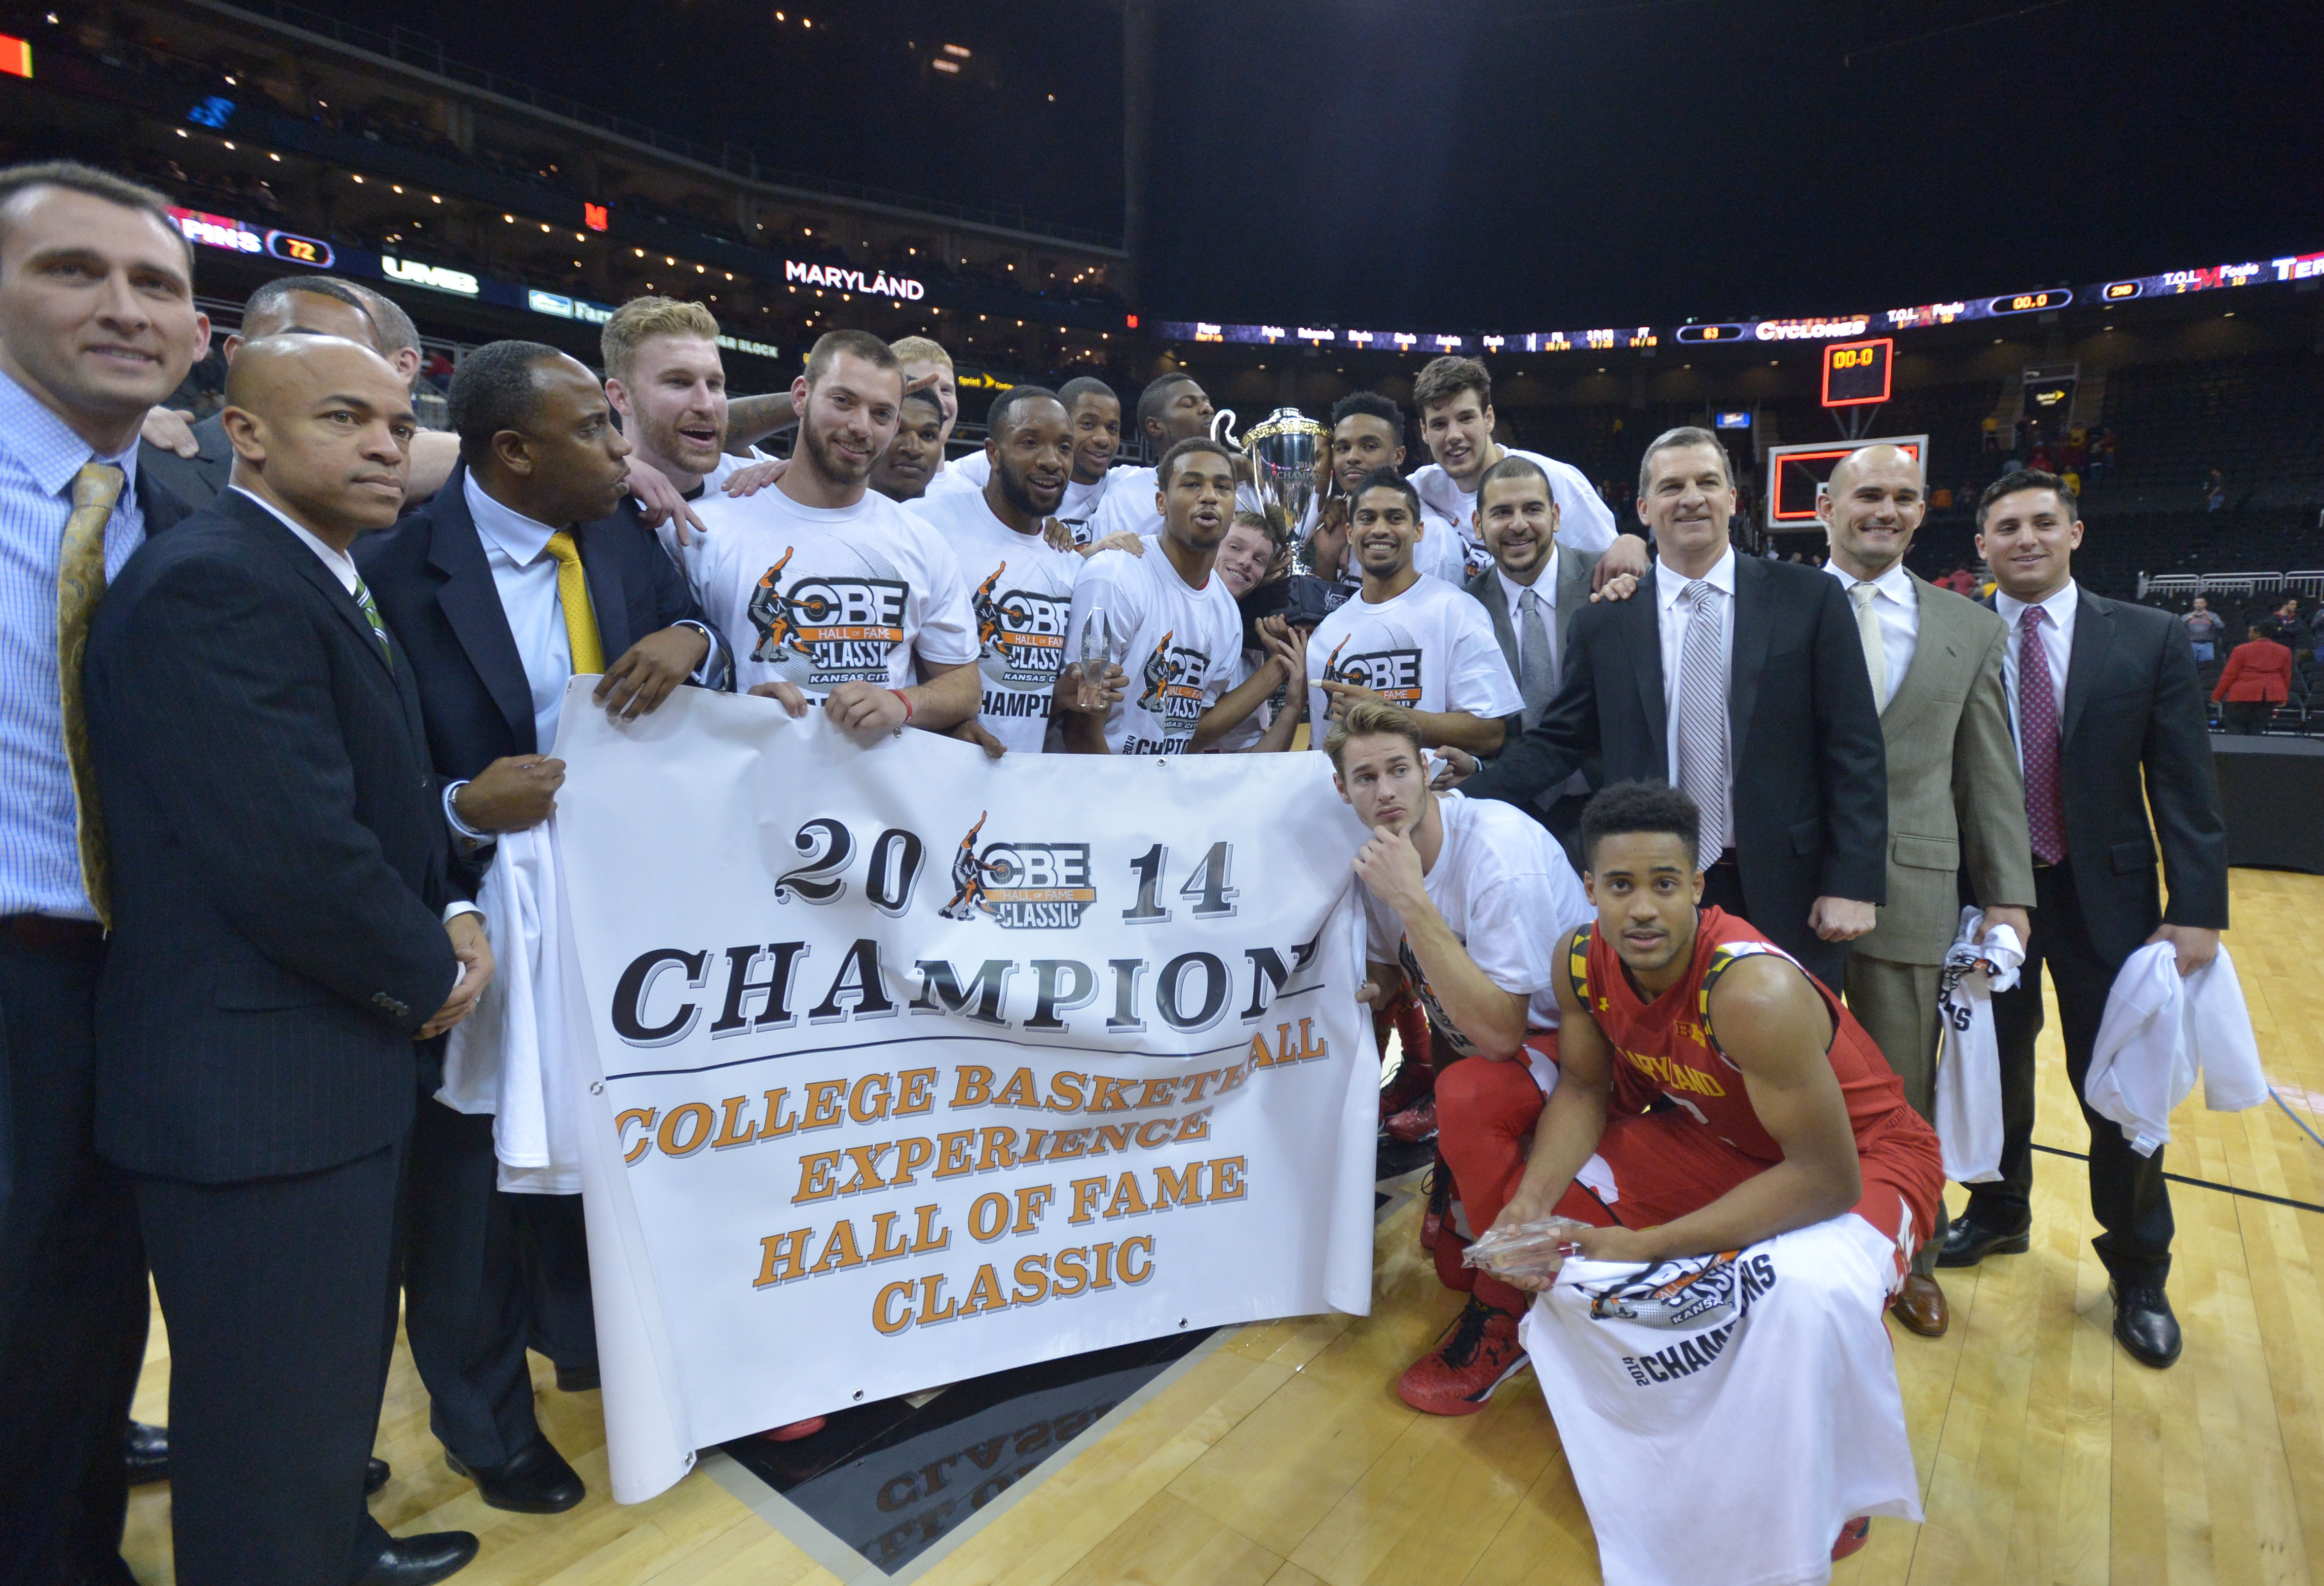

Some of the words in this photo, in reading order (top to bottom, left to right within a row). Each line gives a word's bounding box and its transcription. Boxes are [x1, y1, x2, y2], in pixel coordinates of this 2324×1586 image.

[168, 215, 263, 252] PINS
[786, 260, 924, 300] MARYLAND
[2220, 262, 2260, 279] Fouls
[2232, 276, 2247, 286] 10
[1755, 320, 1866, 341] CYCLONES
[738, 338, 779, 359] BLOCK
[1833, 348, 1873, 369] 00.0
[793, 583, 904, 627] CBE
[818, 628, 850, 639] HALL
[863, 628, 890, 639] FAME
[1015, 634, 1037, 646] HALL
[815, 641, 891, 669] CLASSI
[810, 674, 864, 683] KANSAS
[1004, 673, 1046, 682] KANSAS
[1341, 655, 1416, 692] CBE
[1384, 690, 1408, 700] FAME
[982, 849, 1084, 888] CBE
[1003, 890, 1032, 901] HALL
[1045, 890, 1074, 900] FAME
[999, 902, 1078, 927] CLASSIC
[1617, 1047, 1726, 1097] ARYLAND
[614, 1065, 941, 1168] COLLEGE
[791, 1105, 1214, 1206] EXPERIENCE
[752, 1203, 952, 1289] HALL
[967, 1183, 1056, 1245] OF
[1068, 1155, 1248, 1226] FAME
[871, 1233, 1156, 1338] CLASSIC
